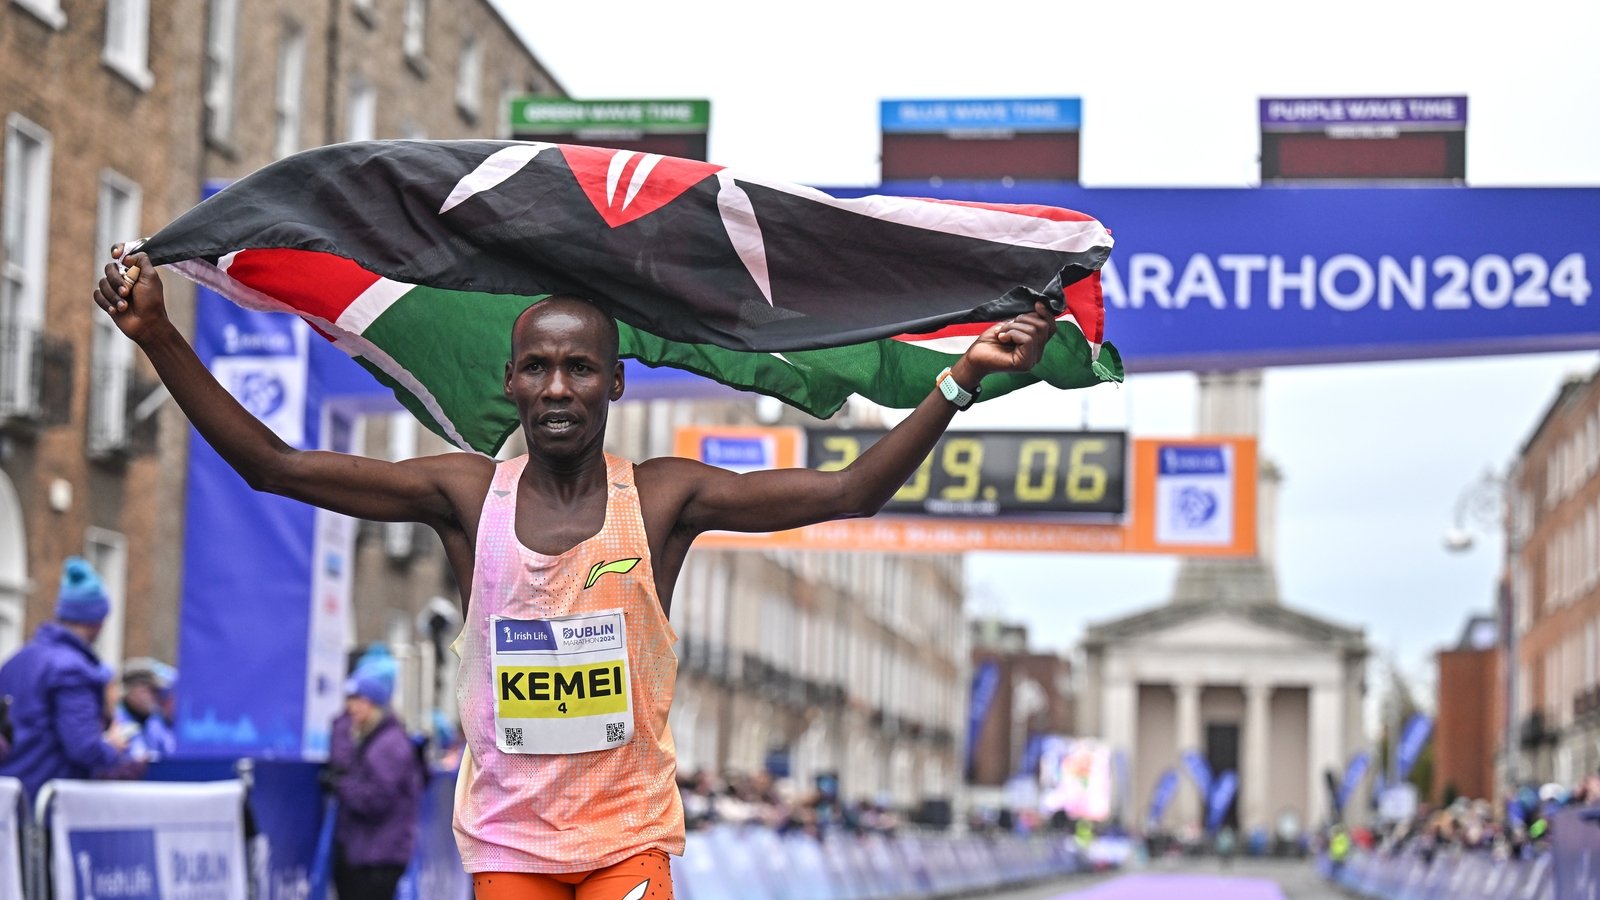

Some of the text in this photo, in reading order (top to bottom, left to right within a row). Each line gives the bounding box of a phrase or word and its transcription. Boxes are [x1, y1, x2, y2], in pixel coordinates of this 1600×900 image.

[591, 103, 642, 121] WAVE
[900, 102, 1057, 121] BLUE WAVE TIME
[1268, 99, 1456, 121] PURPLE WAVE TIME
[514, 632, 548, 641] Irish Life
[563, 623, 614, 639] DUBLIN
[501, 666, 622, 701] KEMEI
[557, 702, 568, 714] 4
